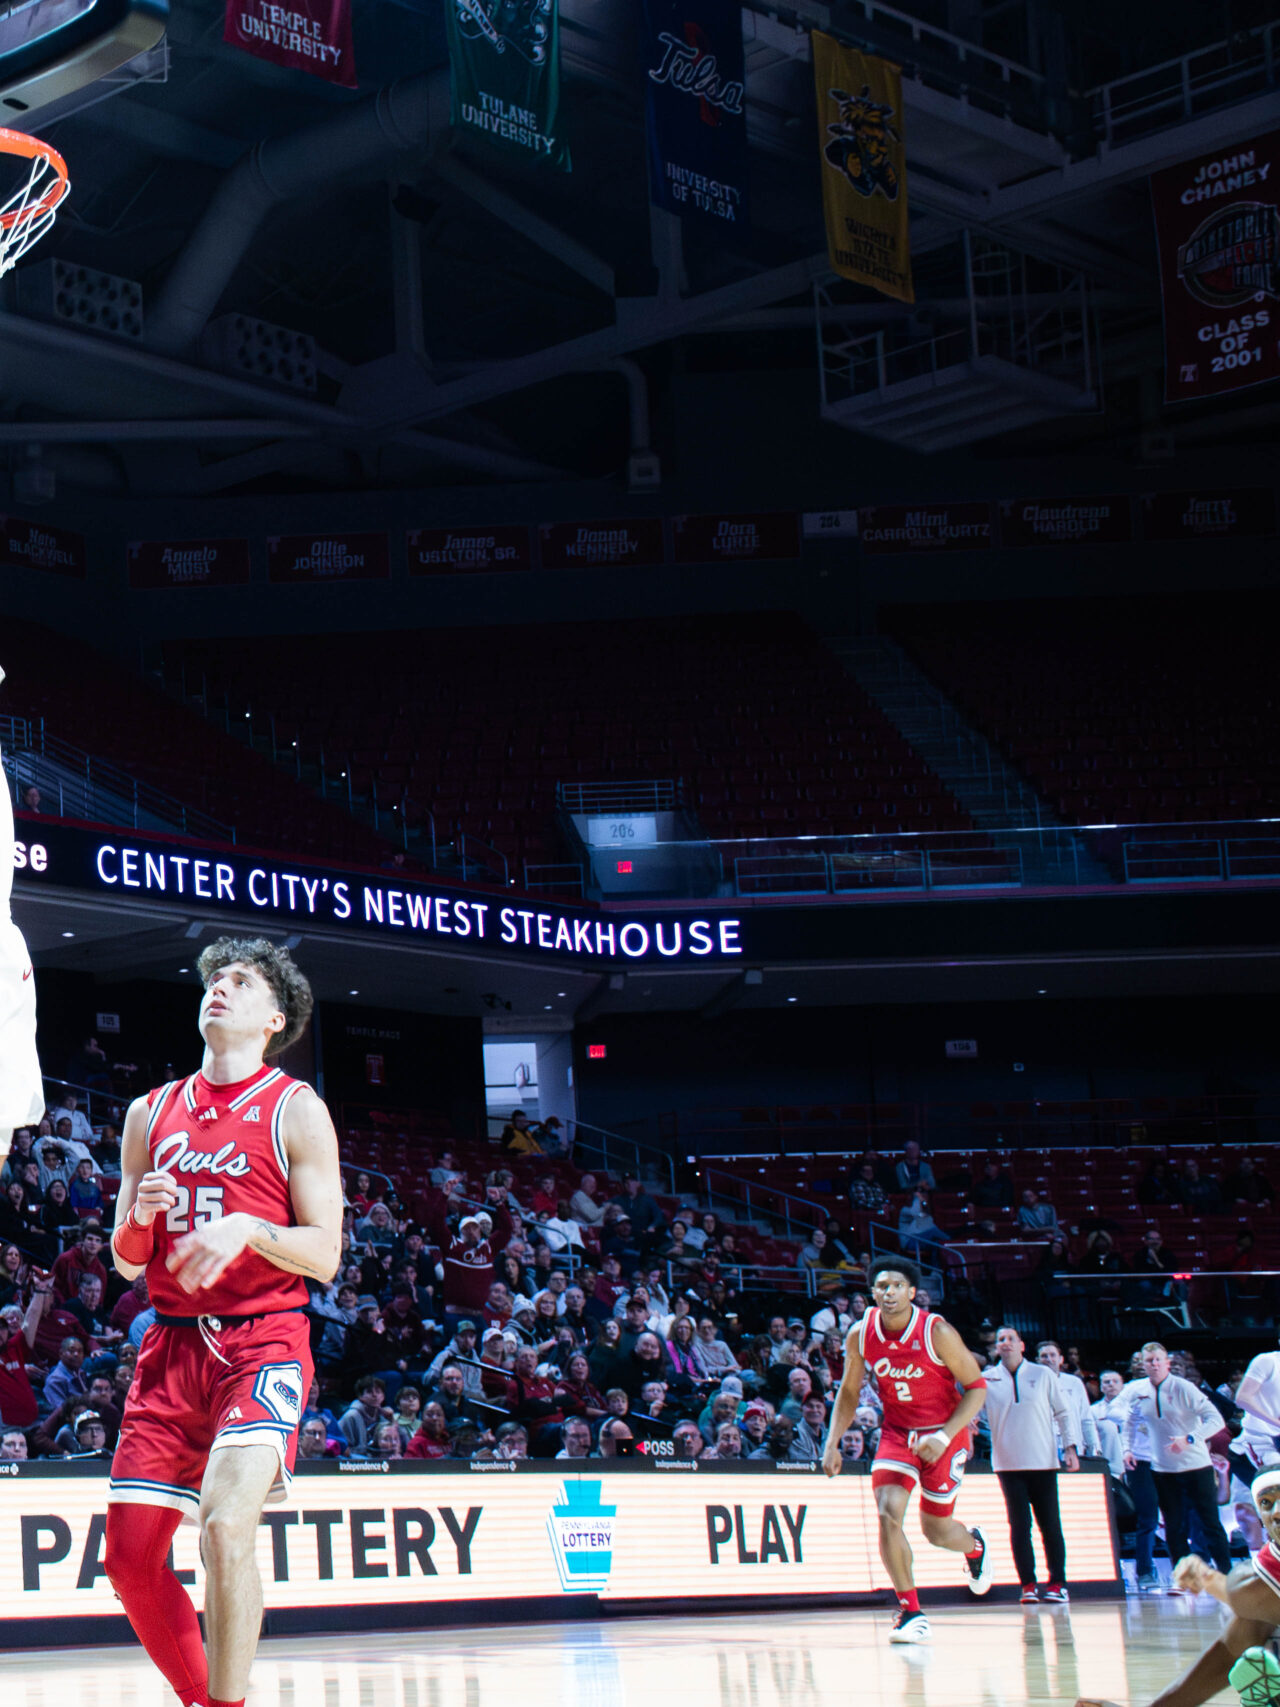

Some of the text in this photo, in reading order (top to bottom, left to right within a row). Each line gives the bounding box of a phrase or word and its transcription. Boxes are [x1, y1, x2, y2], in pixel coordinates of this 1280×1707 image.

[260, 1, 322, 41] TEMPLE
[240, 13, 342, 67] UNIVERSITY
[648, 32, 744, 115] Tulsa
[478, 91, 538, 132] TULANE
[461, 103, 556, 155] UNIVERSITY
[1193, 150, 1256, 185] JOHN
[672, 181, 689, 202] OF
[1179, 162, 1271, 206] CHANEY
[1197, 310, 1270, 343] CLASS
[1220, 332, 1249, 354] OF
[1210, 346, 1262, 374] 2001
[904, 510, 950, 528] Mimi
[443, 533, 496, 551] James
[863, 526, 934, 543] CARROLL
[939, 523, 992, 539] KURTZ
[566, 540, 638, 557] KENNEDY
[291, 554, 365, 572] JOHNSON
[97, 845, 743, 957] CENTER CITY'S NEWEST STEAKHOUSE
[154, 1130, 251, 1178] Owls
[166, 1186, 224, 1232] 25
[874, 1357, 925, 1379] Owls
[895, 1381, 913, 1402] 2
[643, 1440, 675, 1456] POSS
[339, 1461, 382, 1473] Independence
[470, 1461, 510, 1472] Independence
[561, 1533, 612, 1547] LOTTERY
[705, 1504, 808, 1565] PLAY
